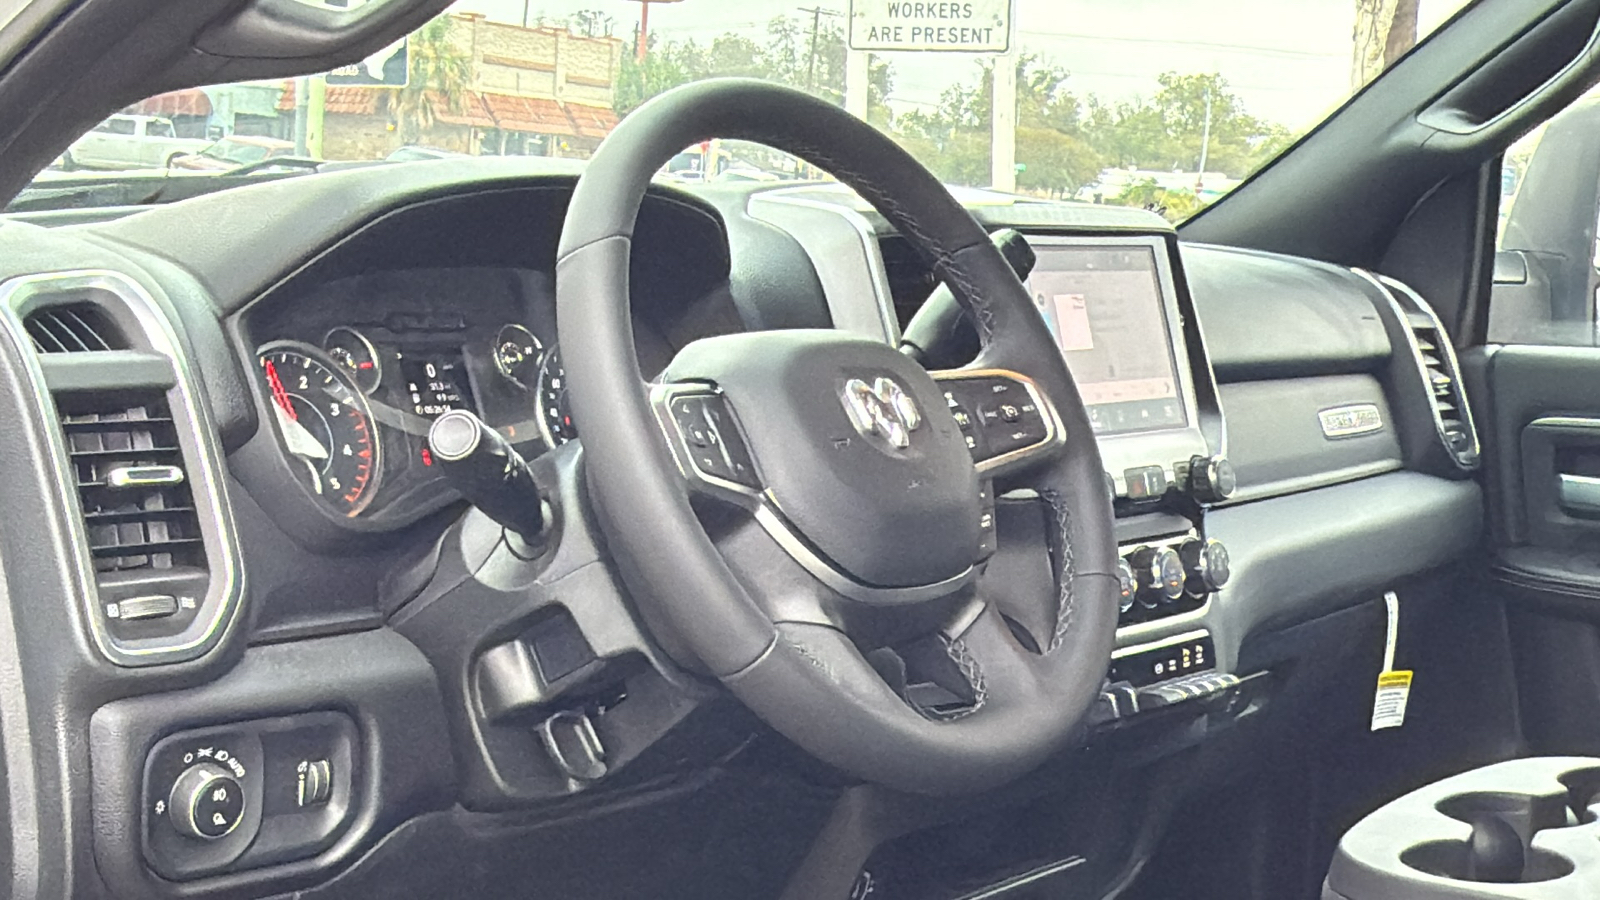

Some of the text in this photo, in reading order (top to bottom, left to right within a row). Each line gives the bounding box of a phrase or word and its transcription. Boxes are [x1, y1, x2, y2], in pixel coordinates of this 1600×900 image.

[888, 3, 973, 19] WORKERS
[868, 26, 993, 44] ARE PRESENT
[299, 375, 309, 390] 2
[330, 402, 341, 417] 3
[227, 757, 246, 778] AUTO
